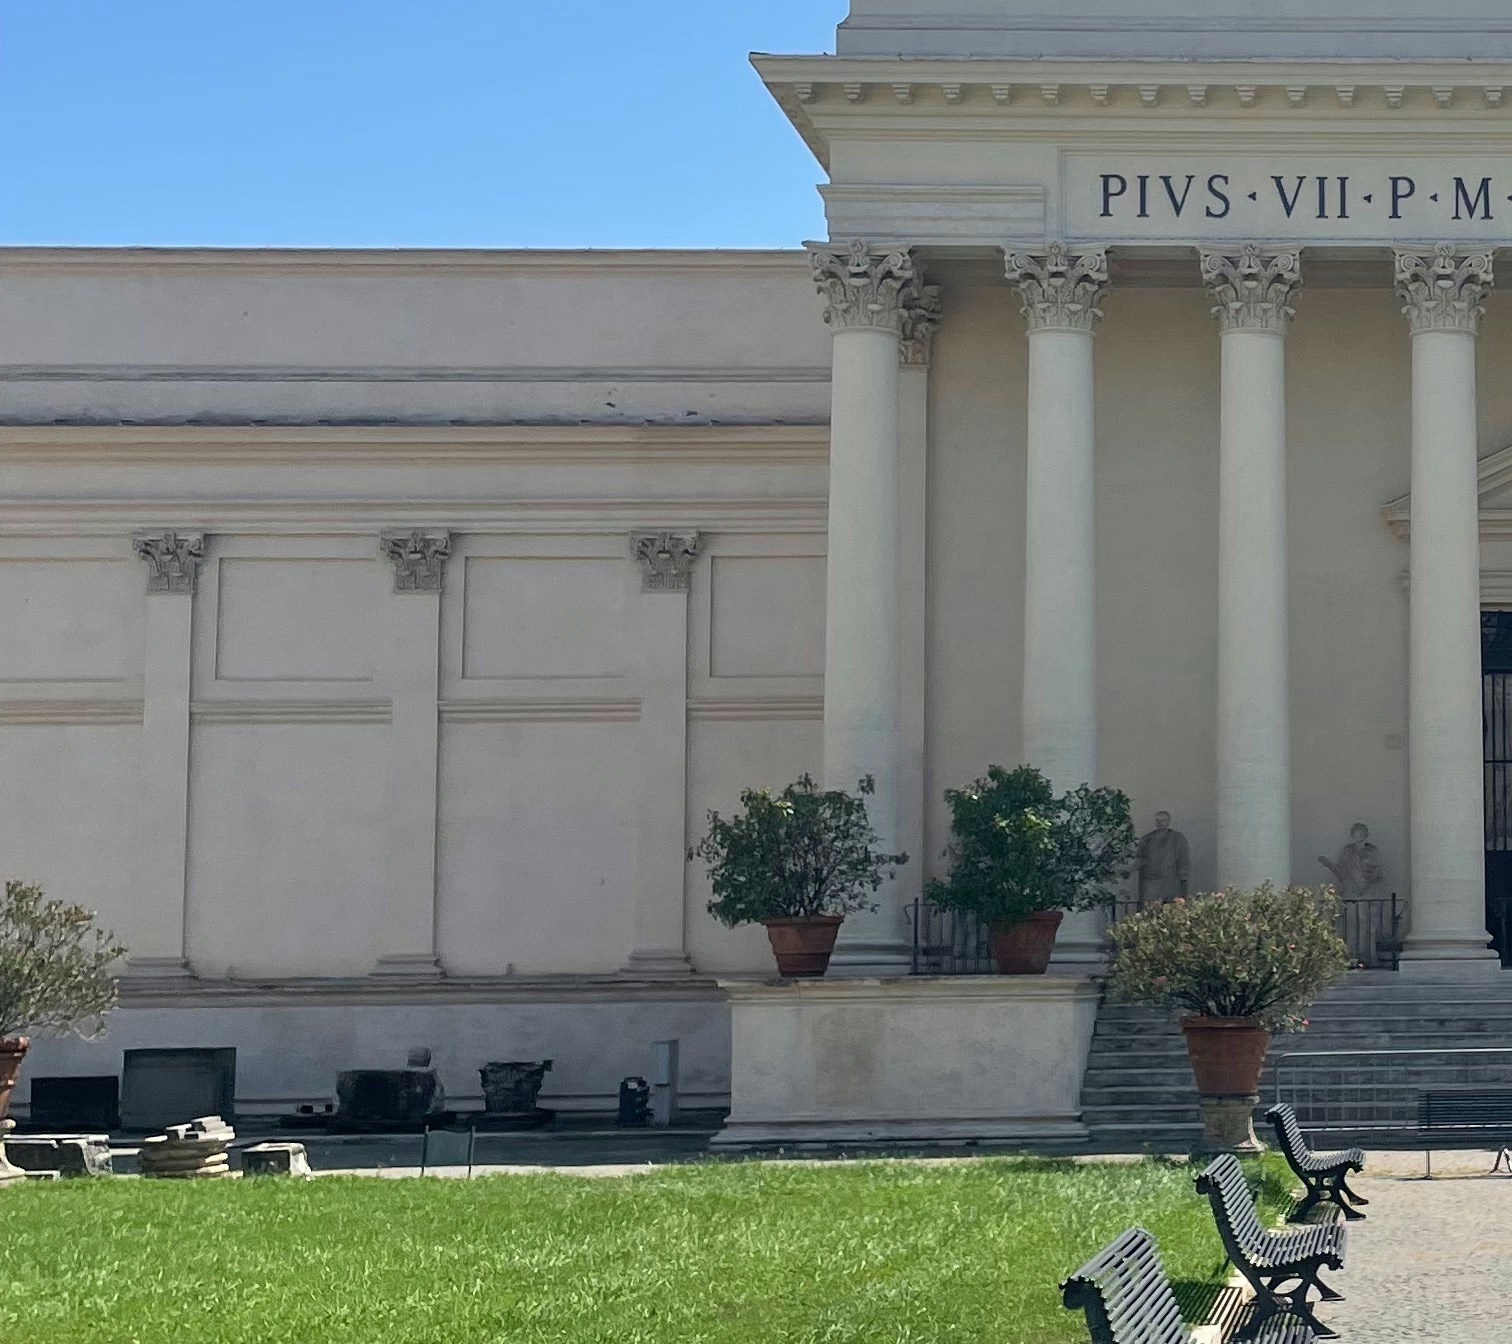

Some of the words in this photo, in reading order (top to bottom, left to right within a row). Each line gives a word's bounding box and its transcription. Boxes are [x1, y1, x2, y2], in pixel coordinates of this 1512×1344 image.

[1099, 173, 1230, 219] PIVS
[1270, 175, 1350, 220] VII
[1388, 176, 1416, 220] P
[1451, 176, 1494, 221] M
